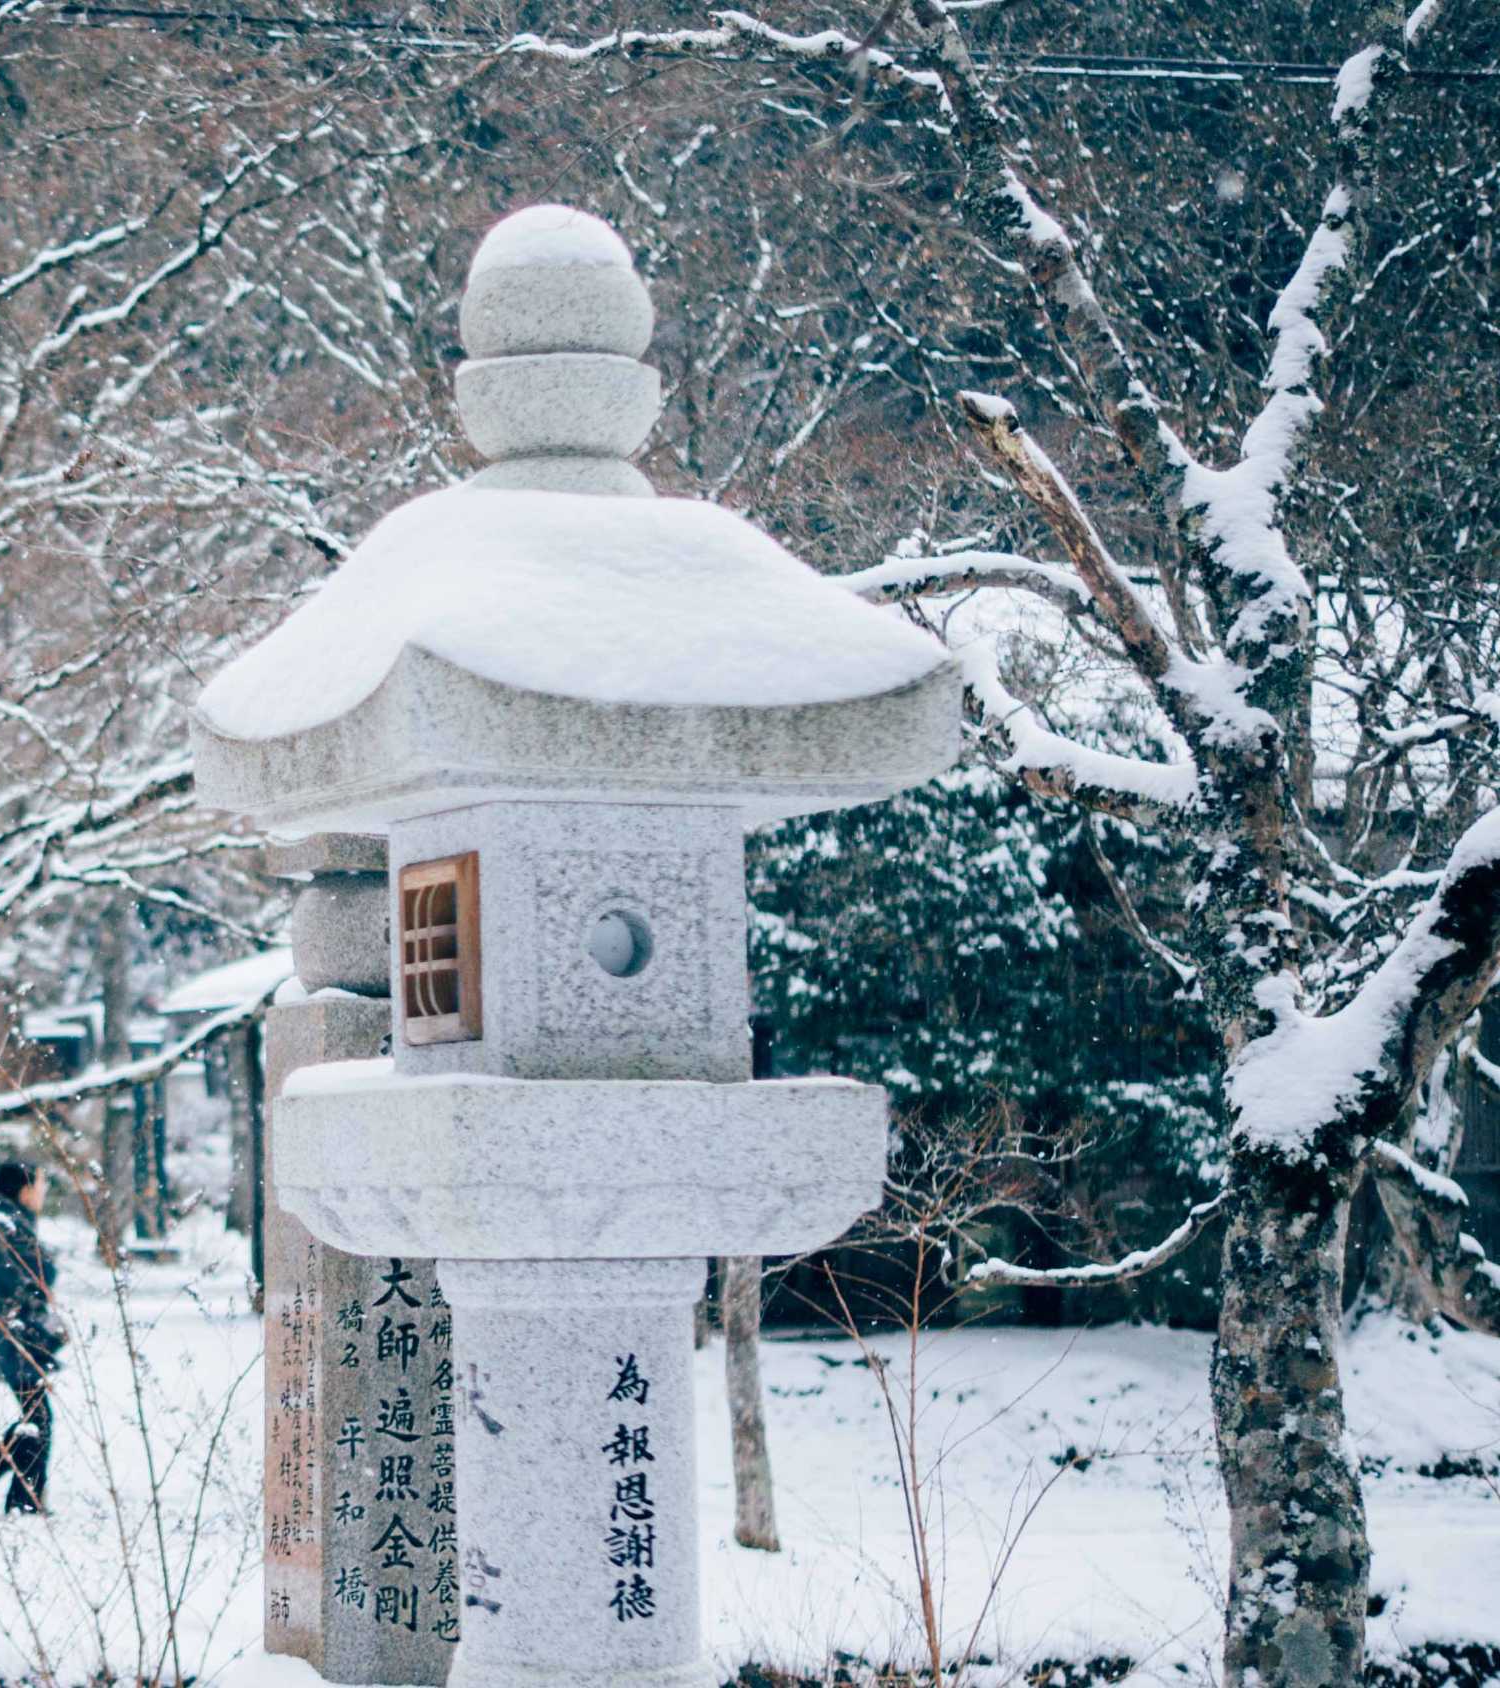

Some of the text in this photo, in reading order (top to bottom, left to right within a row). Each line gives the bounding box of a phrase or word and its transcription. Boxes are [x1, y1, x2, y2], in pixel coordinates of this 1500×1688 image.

[371, 1257, 424, 1632] 大師遍照金剛
